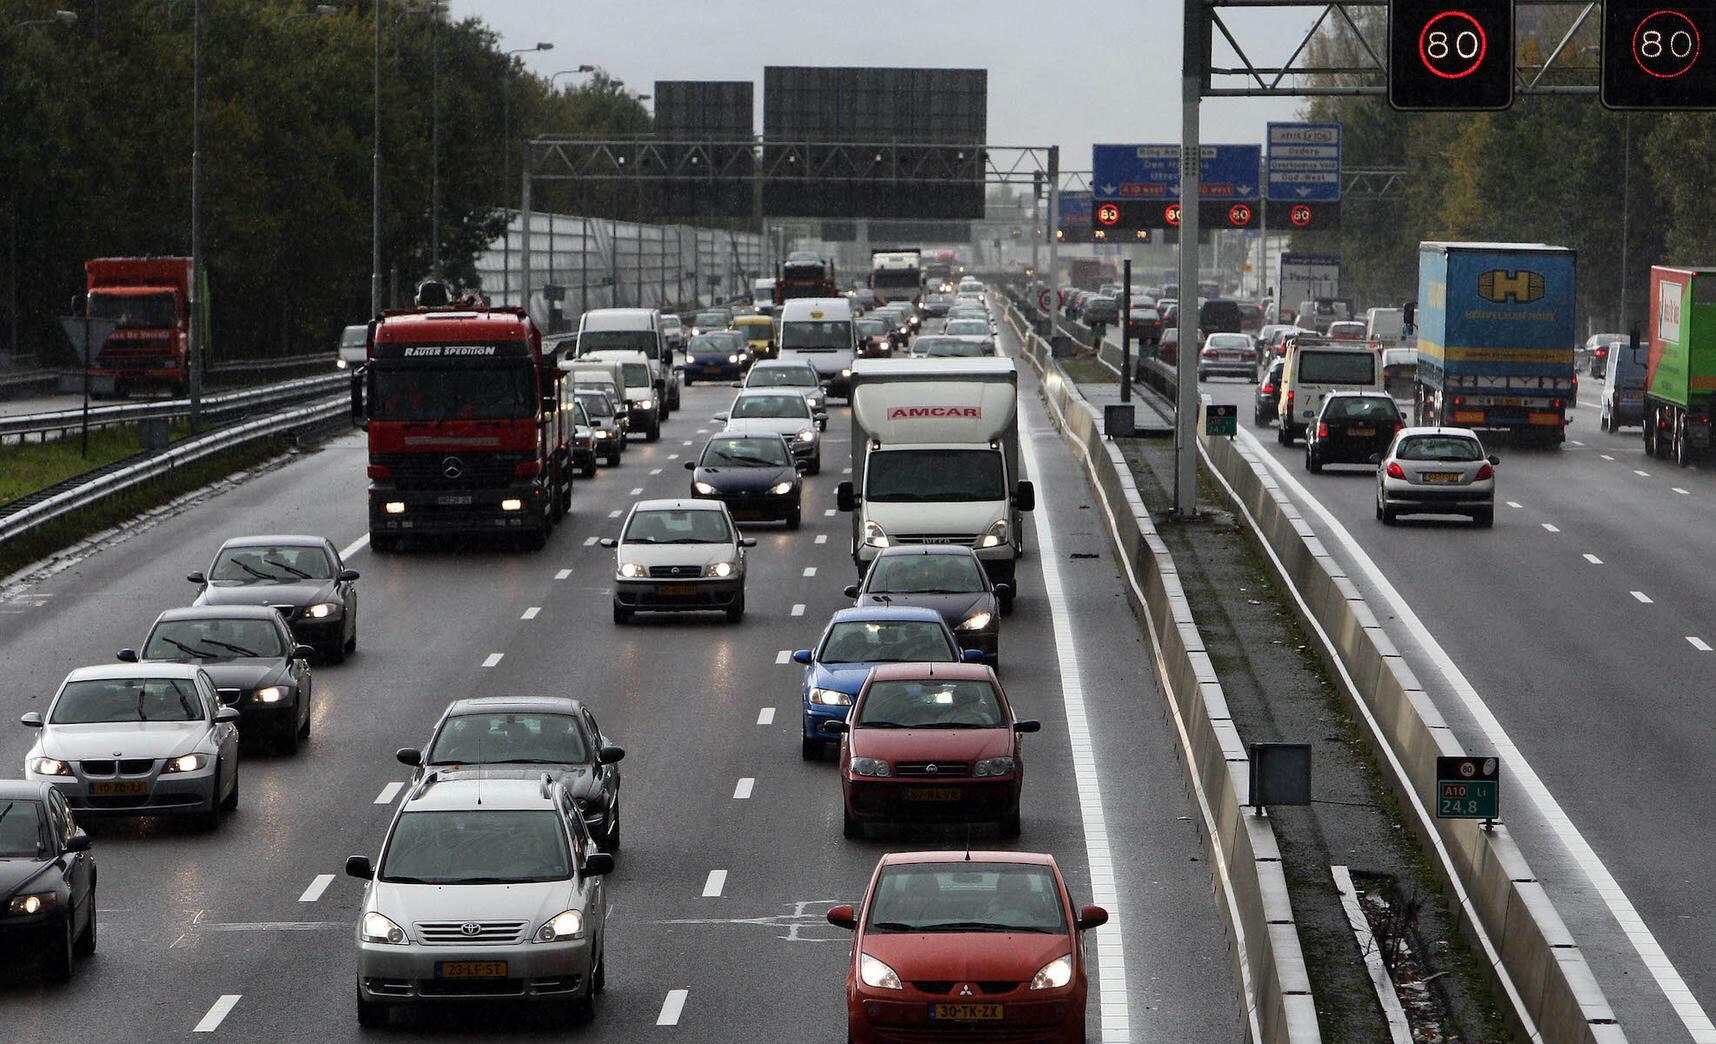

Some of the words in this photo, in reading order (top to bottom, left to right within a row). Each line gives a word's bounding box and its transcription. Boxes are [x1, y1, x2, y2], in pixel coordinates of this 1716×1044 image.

[1427, 31, 1478, 59] 80
[1641, 30, 1692, 58] 80
[1232, 209, 1249, 220] 80
[891, 407, 977, 418] AMCAR
[1445, 786, 1466, 796] A10
[1477, 787, 1486, 797] Li
[1442, 800, 1477, 815] 24,8
[447, 964, 501, 975] 23-LF-ST
[940, 1005, 998, 1018] 30-TK-ZX
